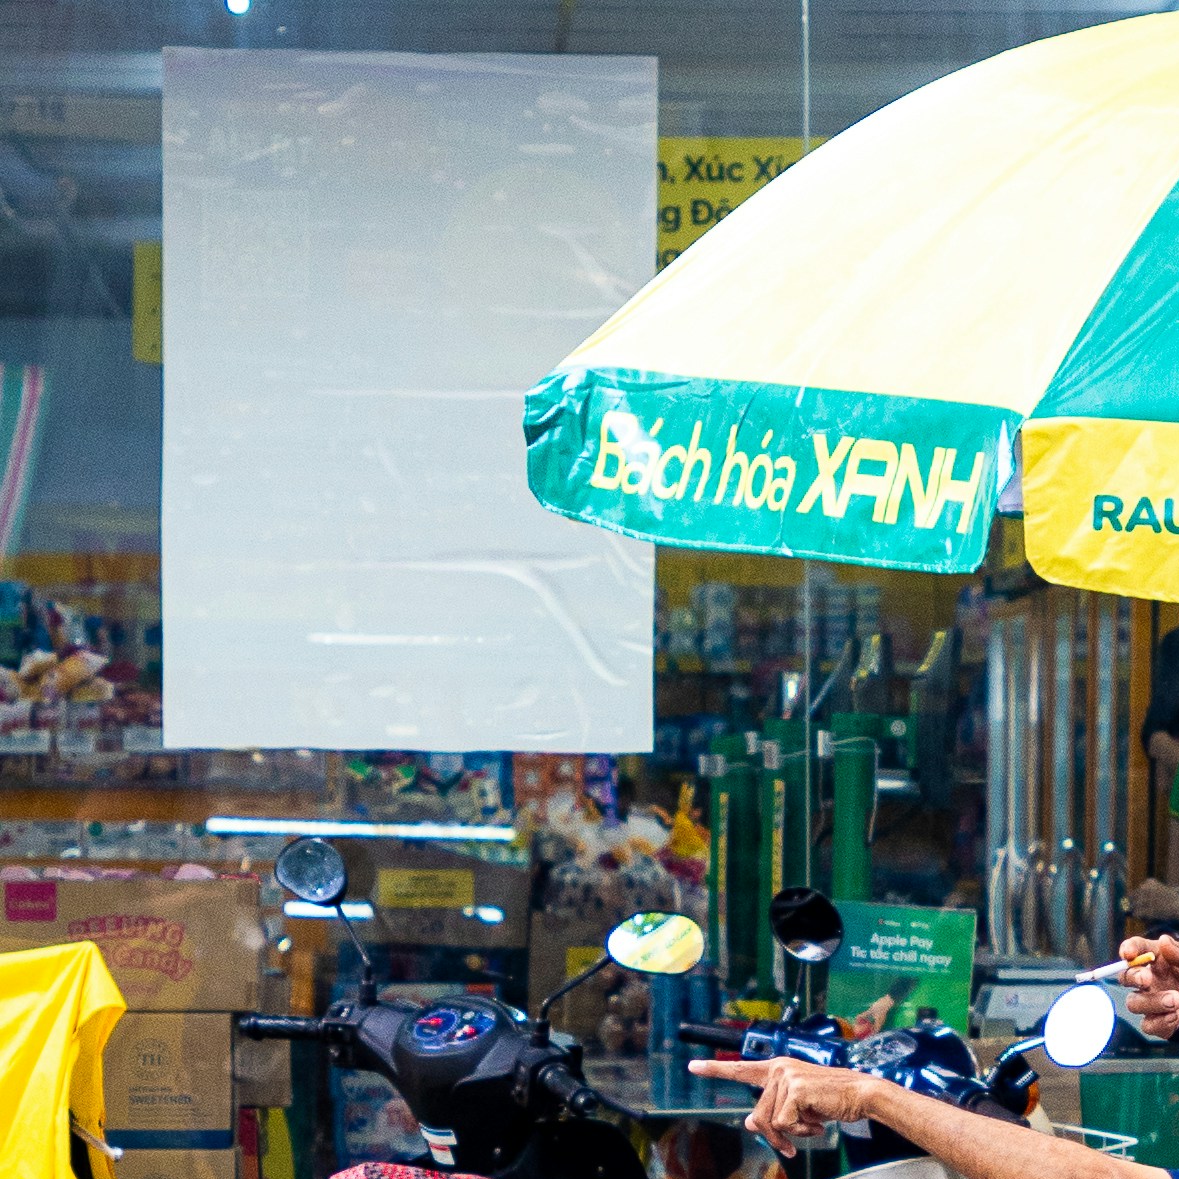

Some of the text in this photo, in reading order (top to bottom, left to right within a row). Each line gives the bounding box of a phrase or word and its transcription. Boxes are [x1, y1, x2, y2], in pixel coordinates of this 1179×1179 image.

[684, 155, 744, 182] Xúc
[590, 410, 985, 534] Bách hóa XANH
[871, 933, 933, 950] Apple Pay
[920, 954, 953, 967] ngay
